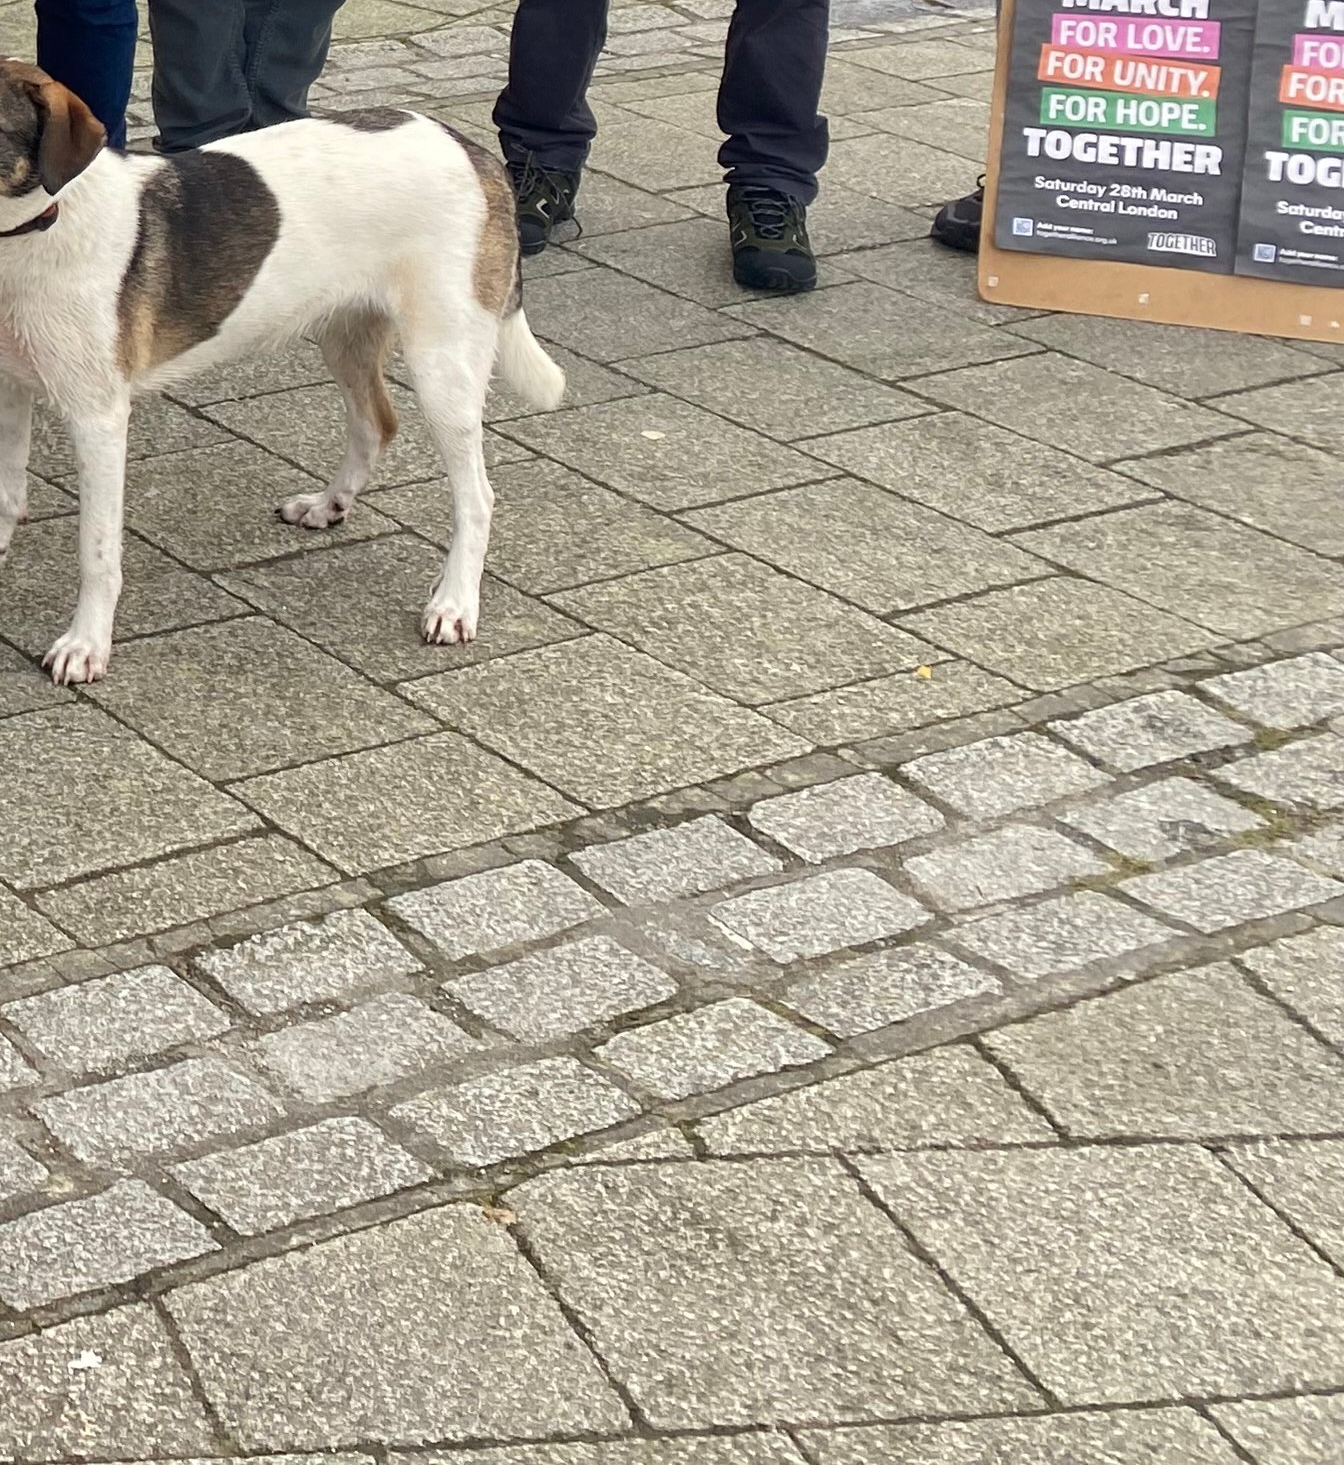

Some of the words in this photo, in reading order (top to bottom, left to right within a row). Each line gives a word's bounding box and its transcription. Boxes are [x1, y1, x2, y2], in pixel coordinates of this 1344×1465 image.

[1060, 20, 1118, 48] FOR
[1127, 23, 1211, 54] LOVE.
[1046, 51, 1106, 83] FOR
[1113, 59, 1211, 98] UNITY.
[1048, 94, 1108, 123] FOR
[1116, 98, 1207, 131] HOPE.
[1023, 127, 1223, 176] TOGETHER
[1034, 176, 1107, 198] Saturday
[1109, 183, 1147, 200] 28th
[1150, 187, 1204, 206] March
[1056, 195, 1115, 213] Central
[1119, 200, 1178, 220] London
[1147, 232, 1217, 257] TOGETHER
